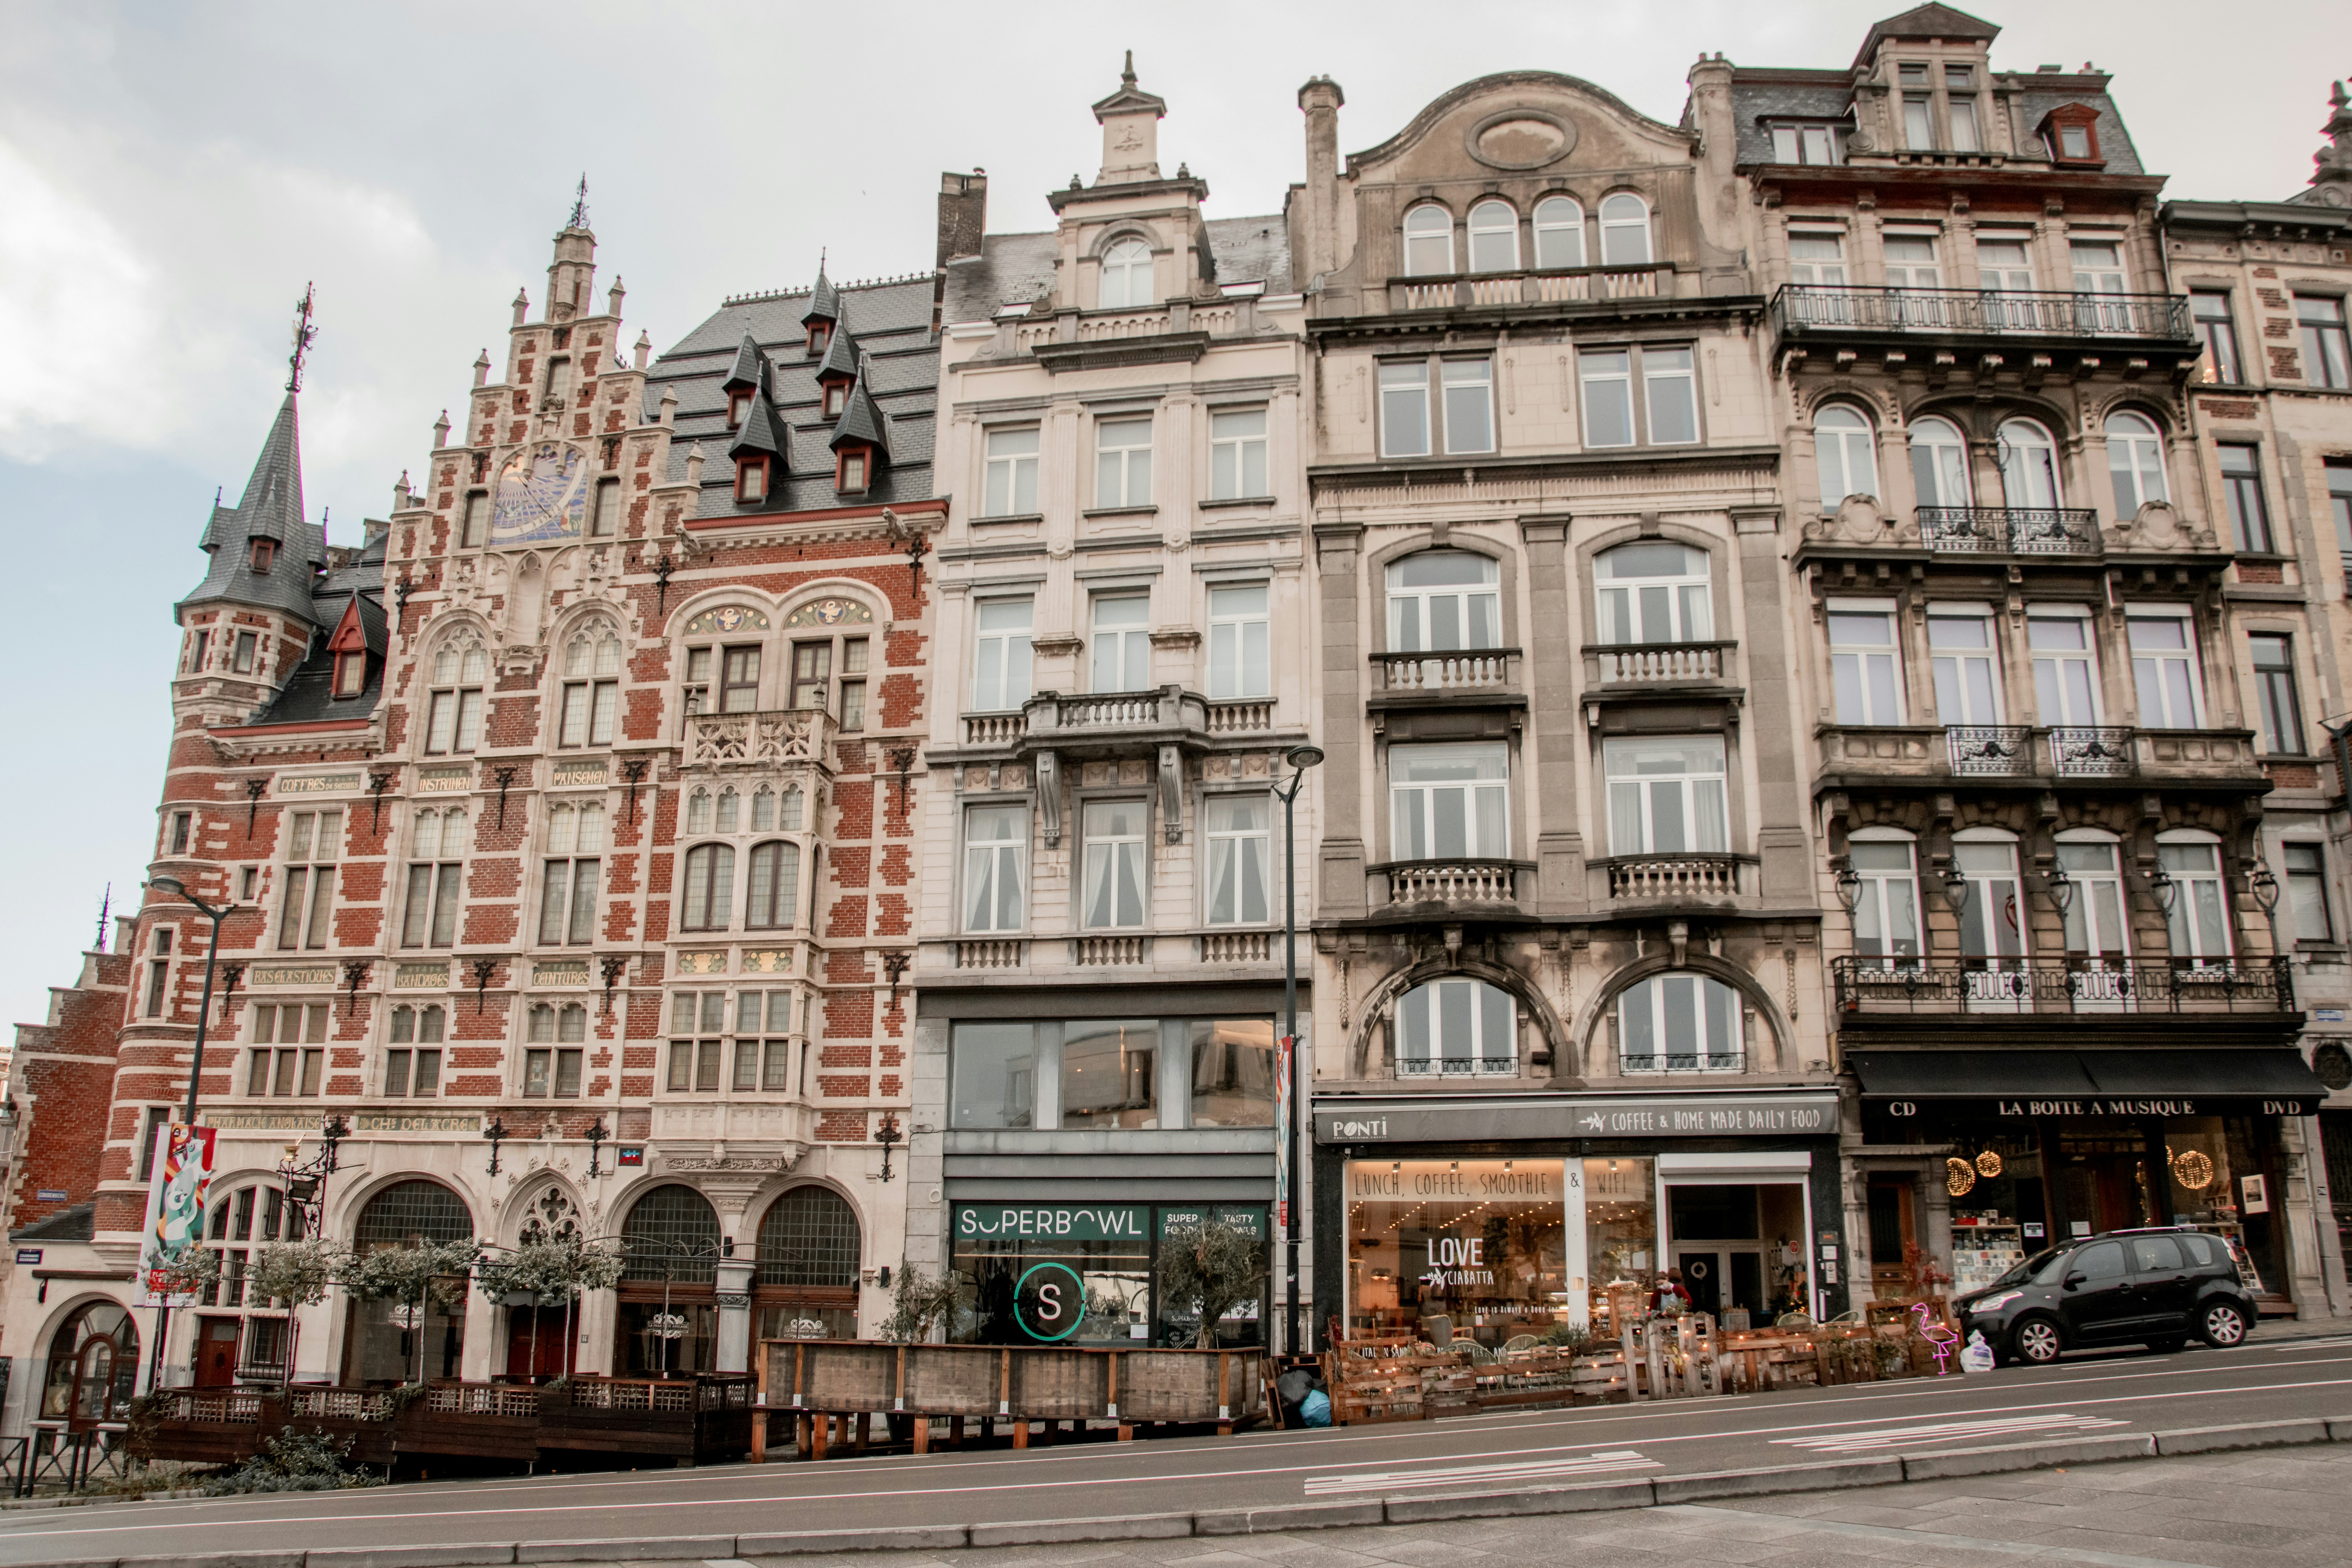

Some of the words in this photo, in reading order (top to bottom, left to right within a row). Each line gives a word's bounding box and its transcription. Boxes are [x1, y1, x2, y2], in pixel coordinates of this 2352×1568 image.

[254, 971, 274, 984] BAS
[396, 974, 449, 987] BANDAGES
[533, 971, 589, 985] CEINTURES
[1889, 1102, 1916, 1116] CD
[1999, 1101, 2024, 1115] LA
[2029, 1101, 2084, 1114] BOITE
[2090, 1101, 2103, 1114] A
[2109, 1101, 2195, 1116] MUSIQUE
[2263, 1101, 2301, 1114] DVD
[206, 1116, 267, 1129] PHARMACIE
[269, 1117, 321, 1129] ANGLAISE
[401, 1118, 468, 1131] DELACRE
[1612, 1112, 1653, 1131] COFFEE
[1660, 1115, 1668, 1127] &
[1674, 1111, 1704, 1130] HOME
[1710, 1110, 1742, 1129] MADE
[1748, 1109, 1784, 1129] DAILY
[1791, 1109, 1820, 1128] FOOD
[1355, 1173, 1404, 1197] LUNCH,
[1415, 1174, 1470, 1197] COFFEE,
[1481, 1172, 1547, 1195] SMOOTHIE
[1571, 1173, 1580, 1187] &
[1597, 1173, 1626, 1194] WIFI
[961, 1209, 1142, 1234] SUPERBOWL
[1167, 1214, 1198, 1223] SUPER
[1224, 1214, 1254, 1223] TASTY
[1428, 1238, 1484, 1267] LOVE
[1448, 1270, 1494, 1285] CIABATTA
[1038, 1283, 1061, 1321] S
